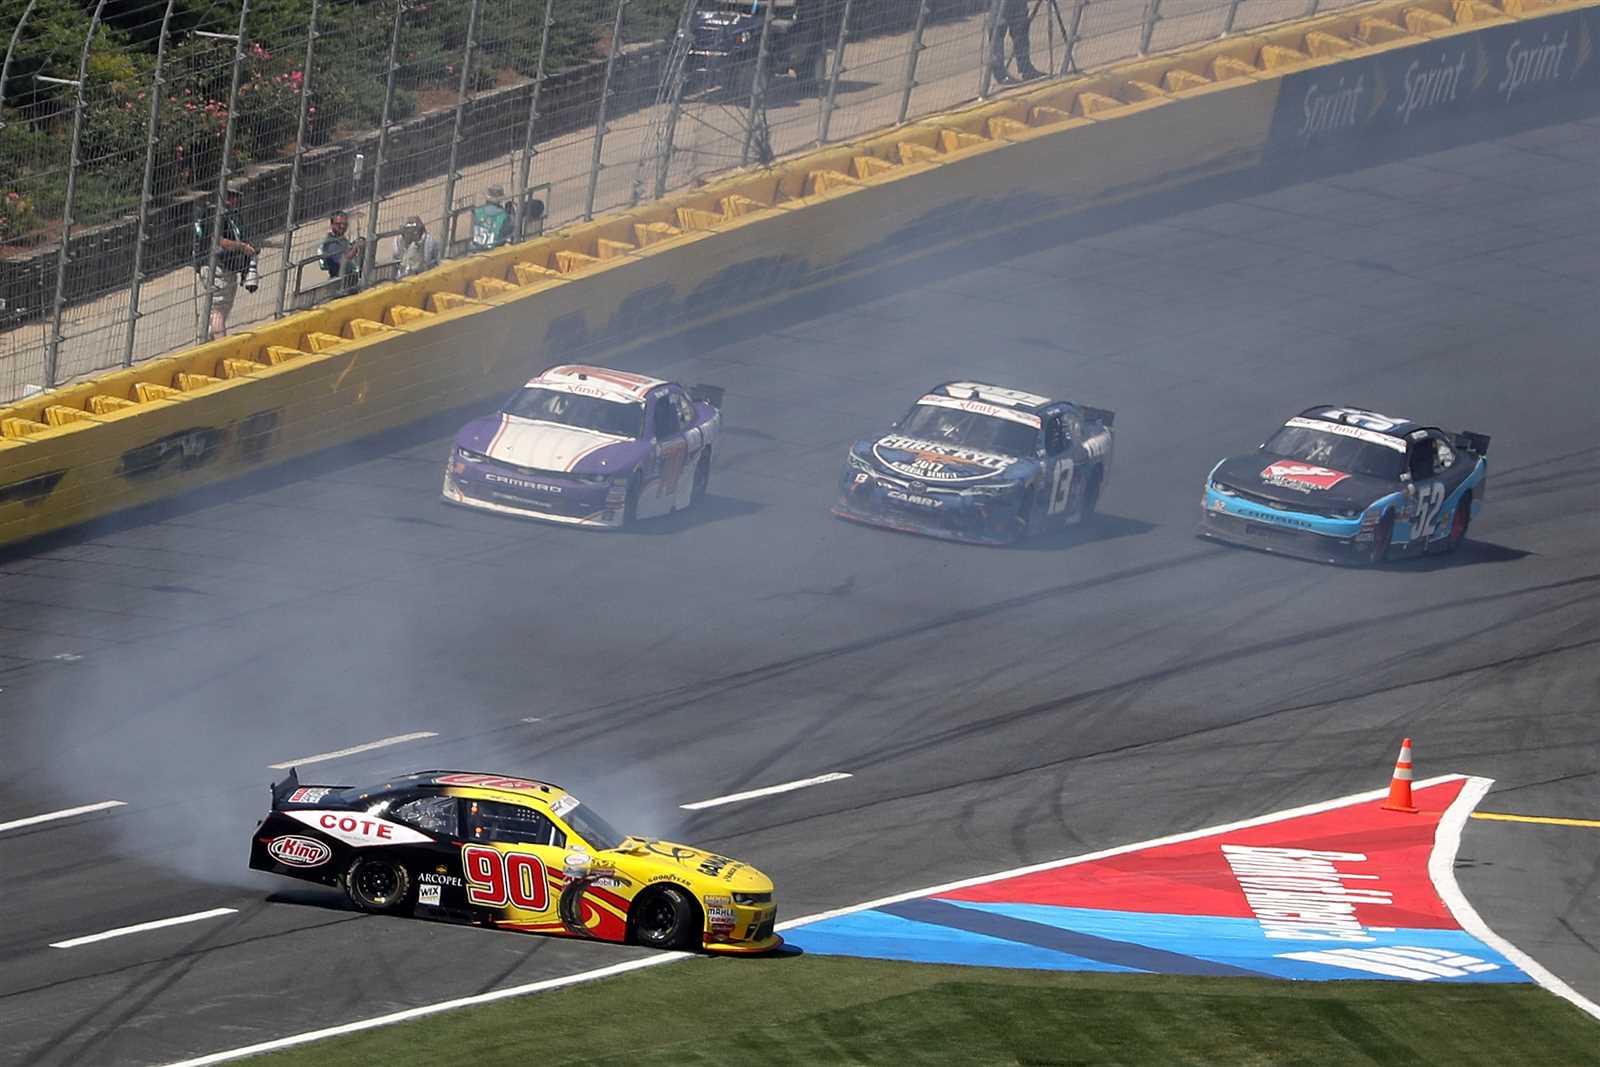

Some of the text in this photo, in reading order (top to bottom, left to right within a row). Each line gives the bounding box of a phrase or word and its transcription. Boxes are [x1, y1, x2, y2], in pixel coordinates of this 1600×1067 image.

[1397, 51, 1465, 125] Sprint
[1499, 30, 1568, 104] Sprint
[1298, 75, 1364, 147] Sprint
[484, 473, 562, 493] CAMARO
[1048, 458, 1074, 514] 13
[1409, 482, 1446, 540] 52
[281, 837, 320, 862] King
[320, 814, 394, 839] COTE
[417, 872, 463, 887] ARCOPEL
[420, 886, 439, 897] WIX
[462, 843, 549, 912] 90
